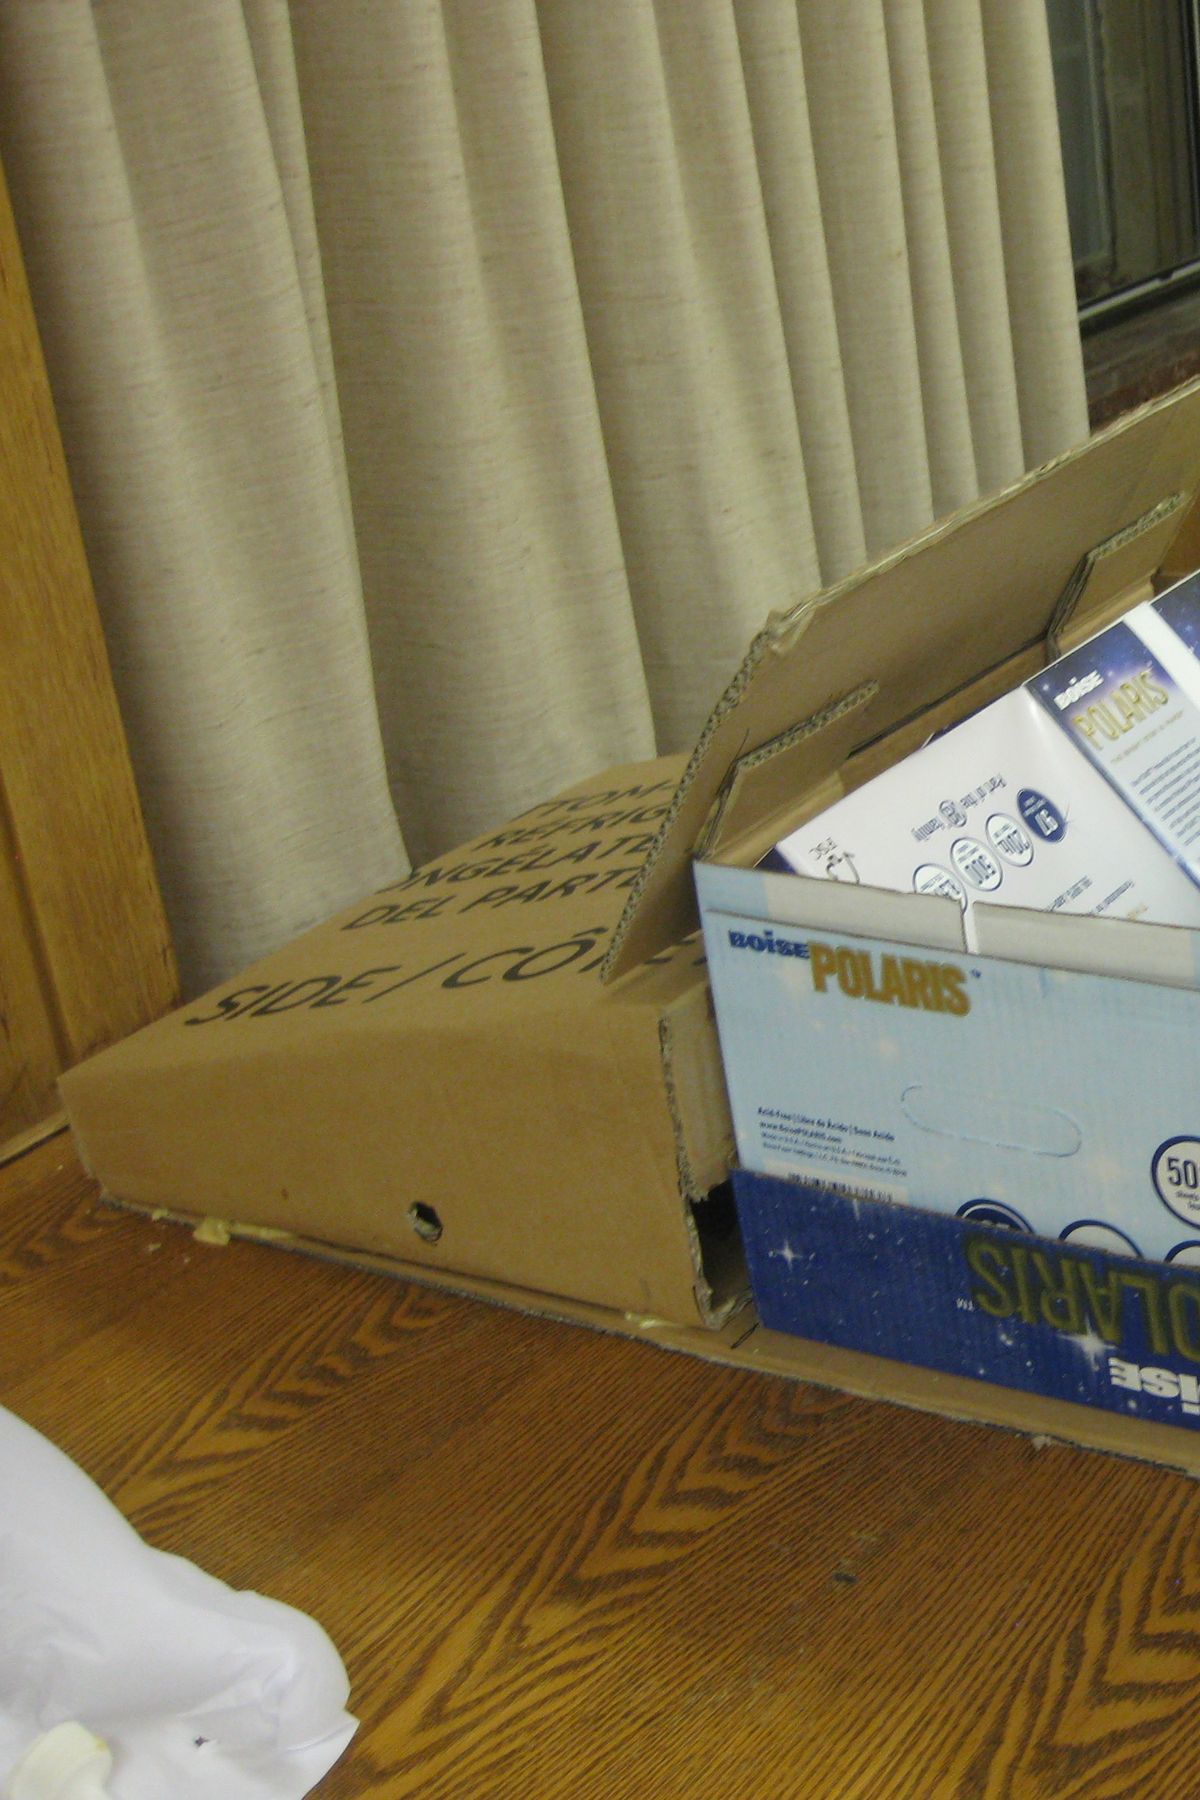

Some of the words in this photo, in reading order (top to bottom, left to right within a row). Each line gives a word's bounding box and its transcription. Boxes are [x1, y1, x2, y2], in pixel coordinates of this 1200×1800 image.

[1071, 671, 1169, 751] POLARIS
[341, 894, 457, 932] DEL
[184, 966, 403, 1026] SIDE
[808, 937, 972, 1018] POLARIS
